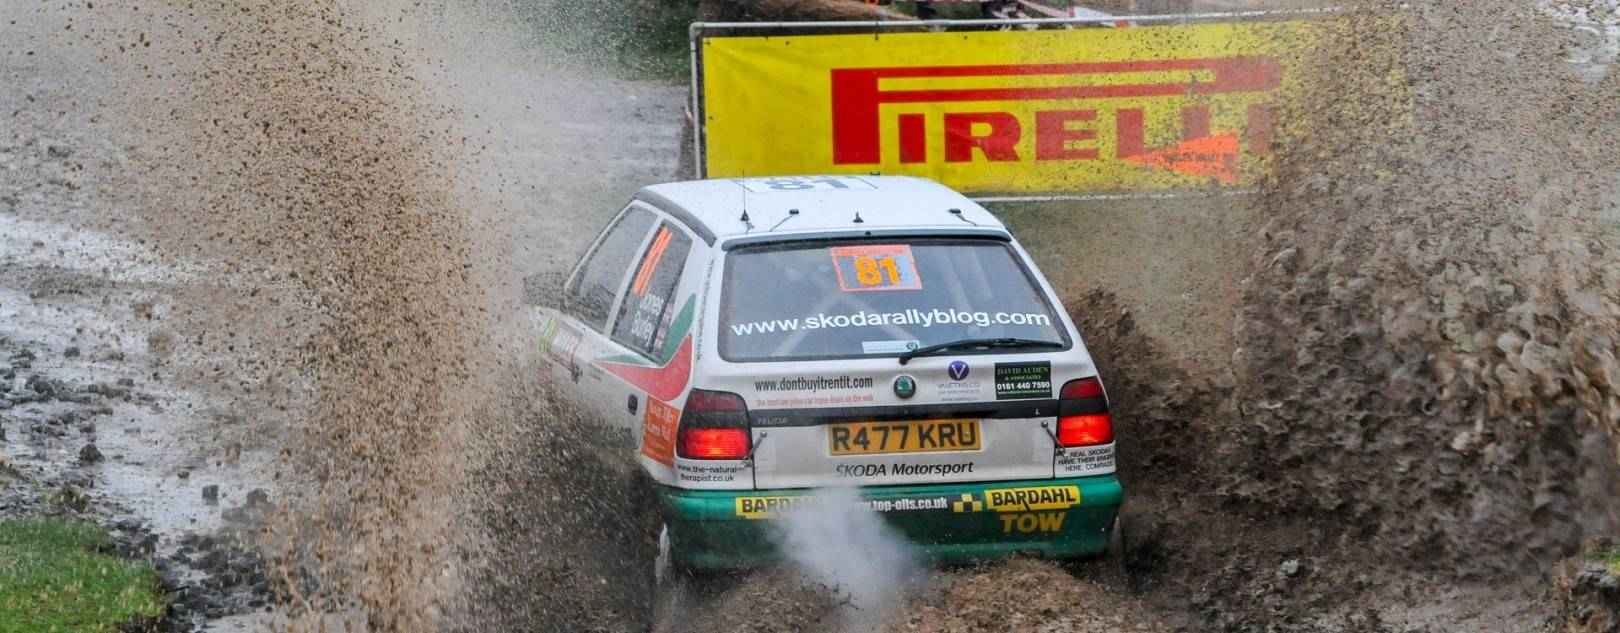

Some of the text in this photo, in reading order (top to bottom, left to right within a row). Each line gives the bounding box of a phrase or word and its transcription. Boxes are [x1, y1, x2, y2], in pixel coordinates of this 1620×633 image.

[831, 56, 1282, 164] PIRELLI
[854, 255, 901, 288] 81
[731, 308, 1051, 336] www.skodarallyblog.com
[755, 376, 873, 393] www.dontbuyitrentit.com
[831, 422, 976, 451] R477 KRU
[891, 462, 974, 477] Motorsport
[991, 488, 1077, 512] BARDAHL
[1000, 512, 1066, 534] TOW
